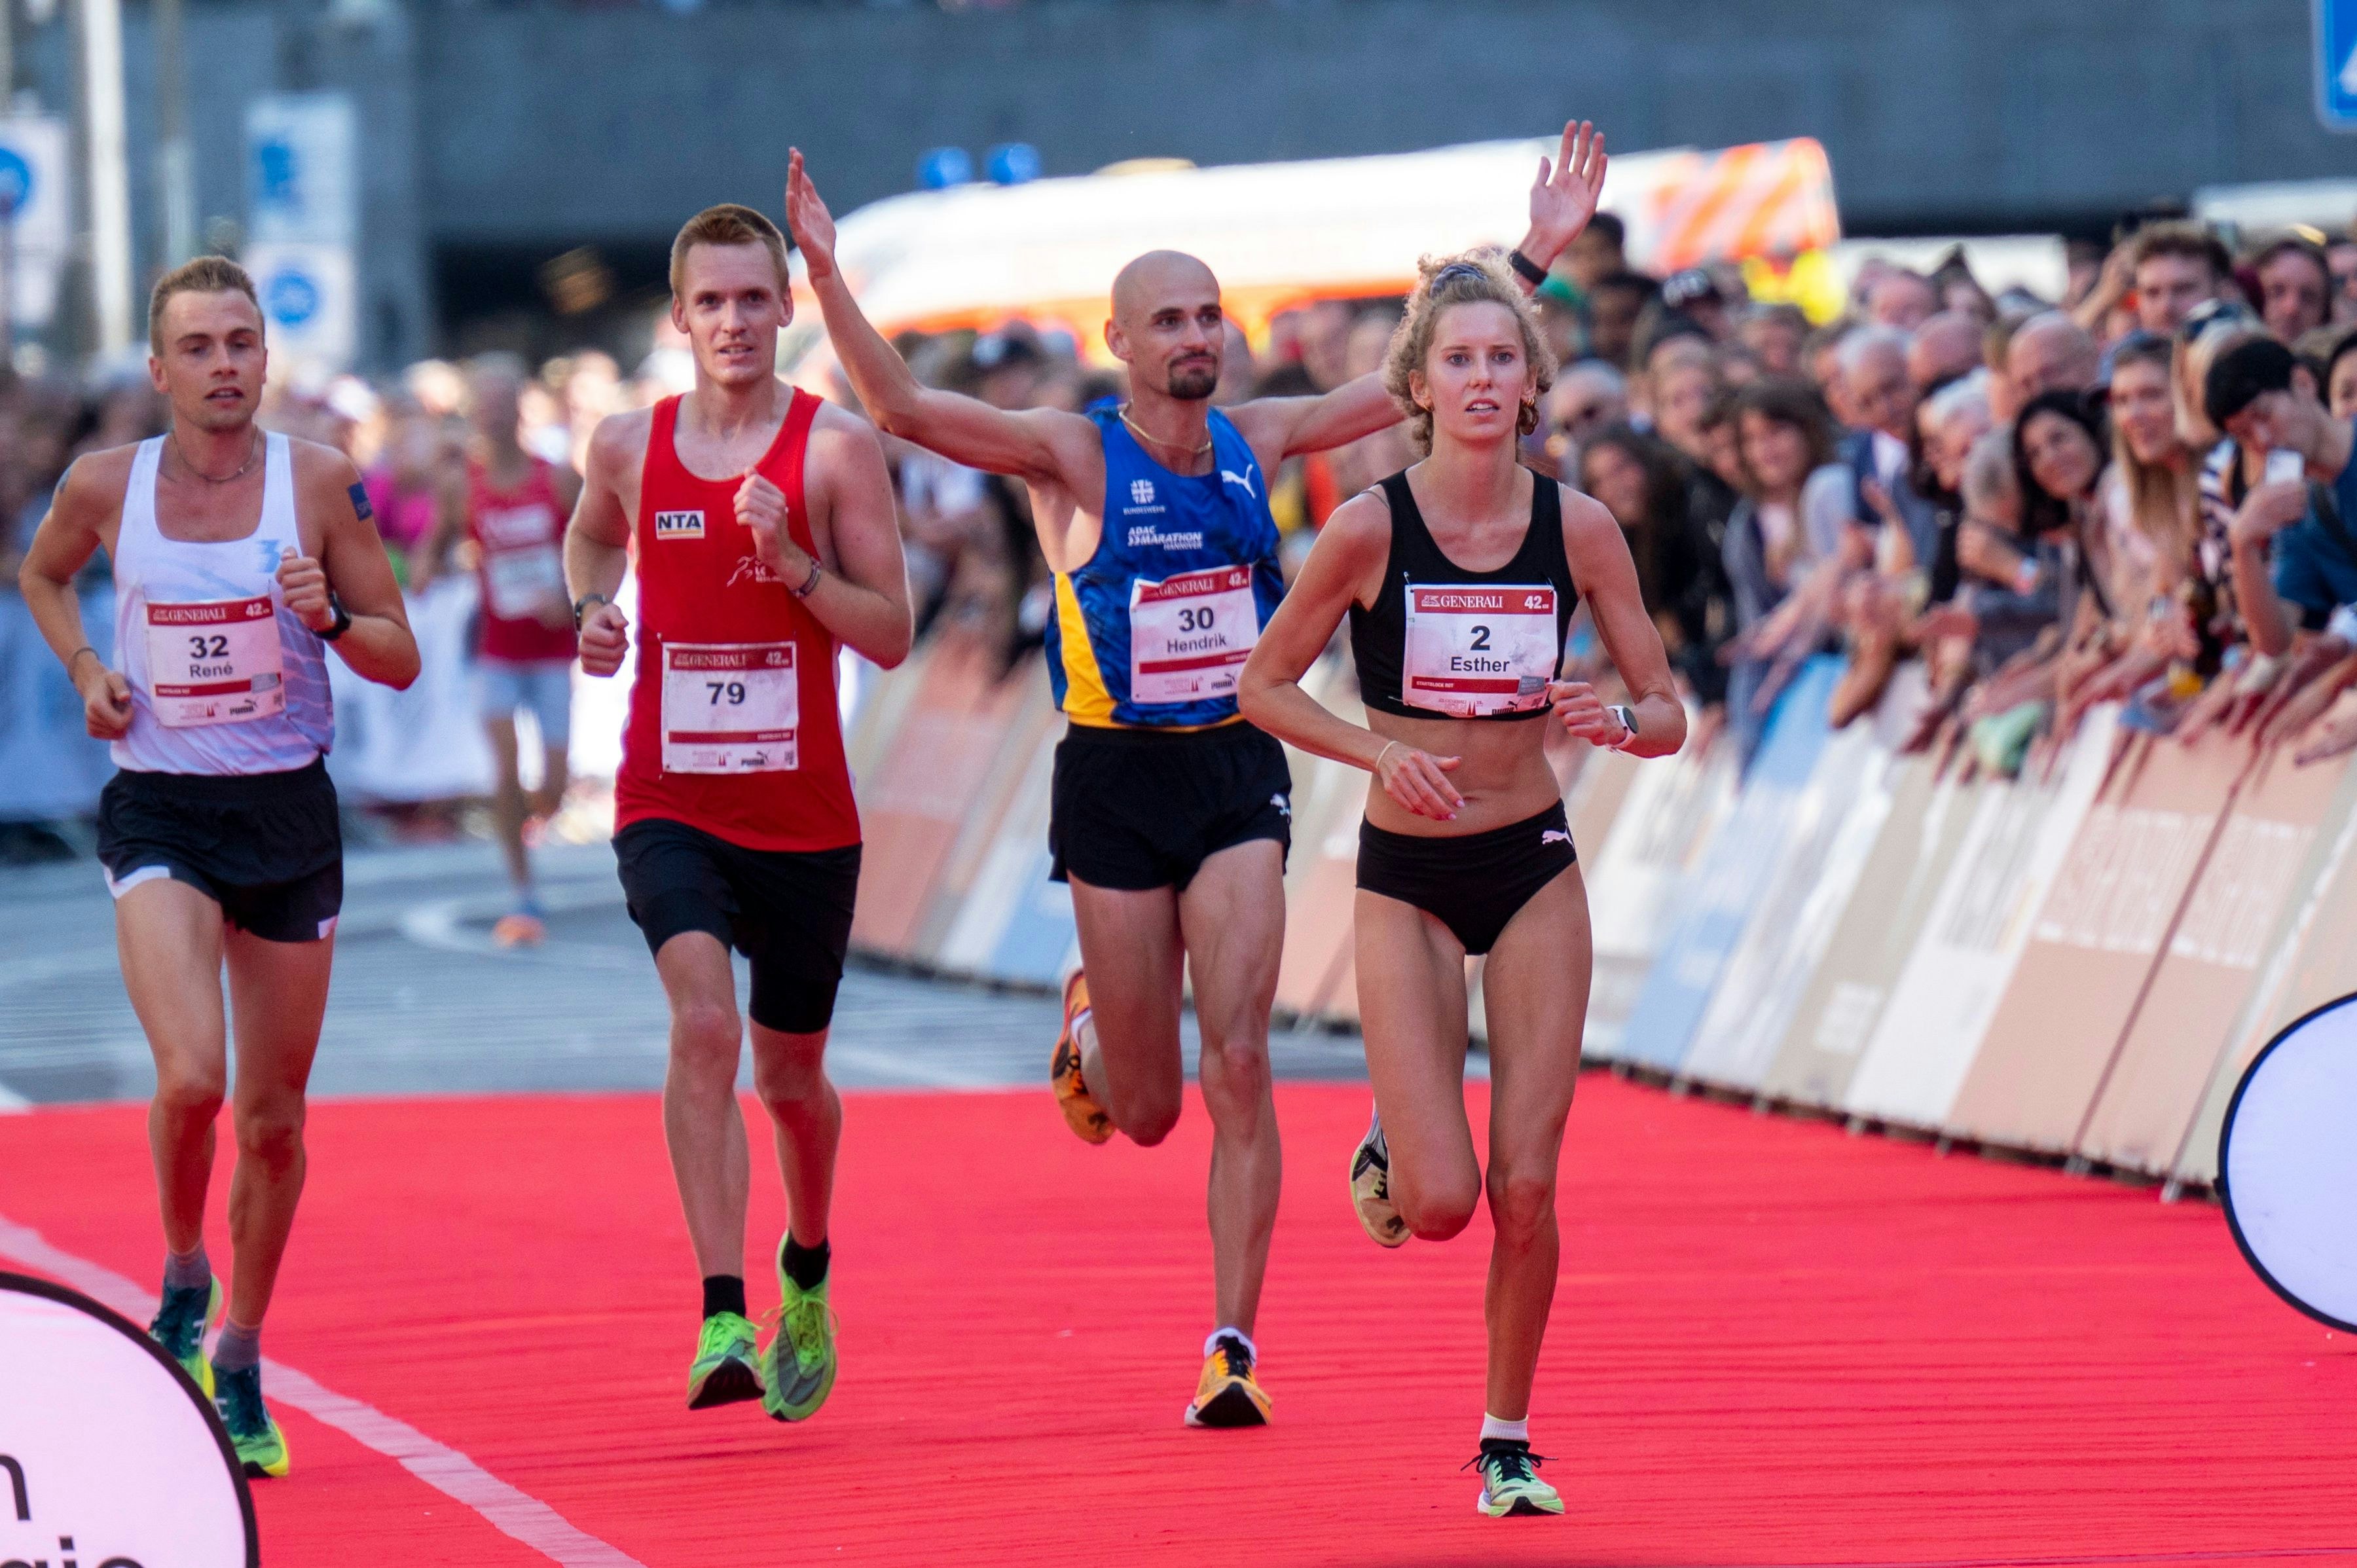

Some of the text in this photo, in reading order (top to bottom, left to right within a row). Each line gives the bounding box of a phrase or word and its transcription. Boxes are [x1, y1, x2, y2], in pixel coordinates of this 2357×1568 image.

[658, 515, 701, 529] NTA
[1128, 526, 1155, 535] ADAC
[1140, 532, 1203, 545] MARATHON
[1159, 572, 1242, 596] GENERALI 42
[1440, 596, 1503, 608] GENERALI
[1524, 595, 1542, 609] 42
[168, 608, 227, 621] GENERALI
[246, 602, 262, 617] 42
[1178, 607, 1215, 632] 30
[1166, 633, 1227, 653] Hendrik
[1470, 625, 1491, 651] 2
[189, 635, 230, 659] 32
[689, 651, 782, 667] GENERALI 42
[1450, 657, 1510, 672] Esther
[189, 662, 234, 678] René
[706, 682, 746, 705] 79
